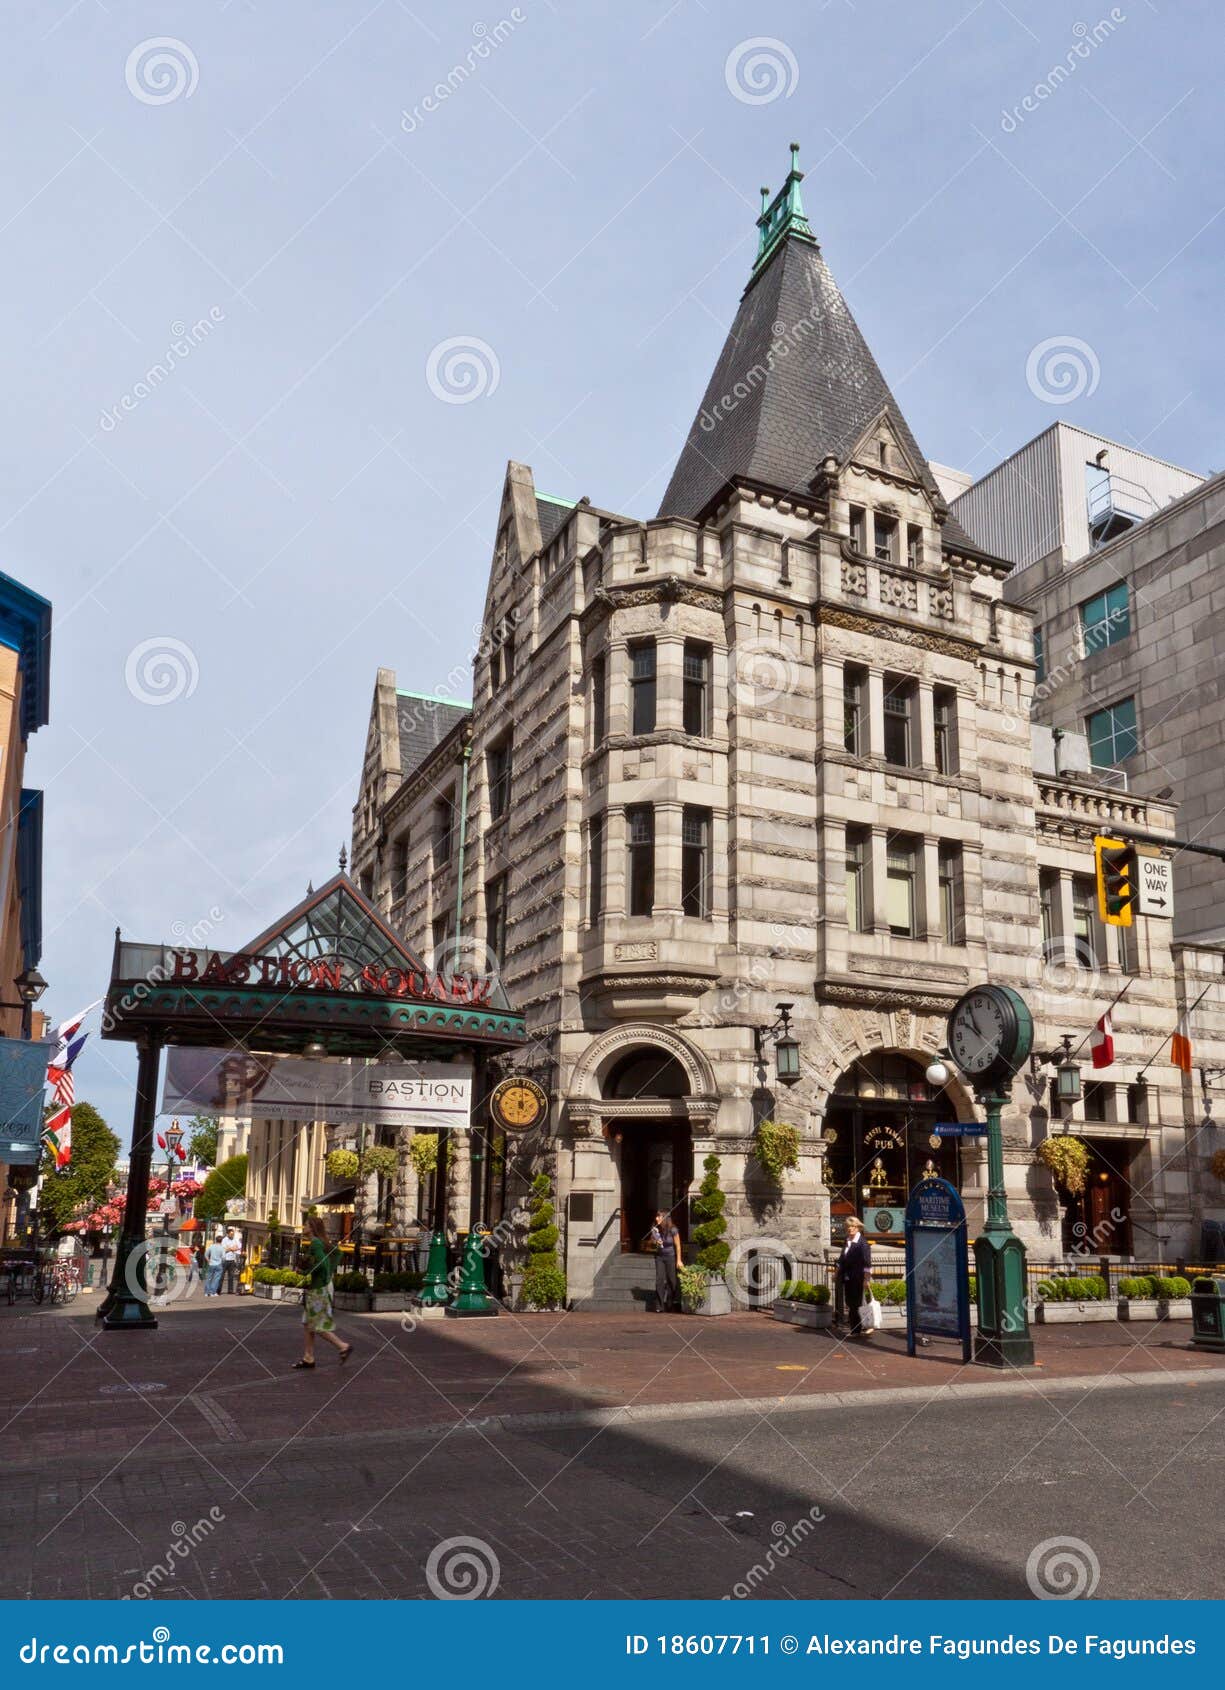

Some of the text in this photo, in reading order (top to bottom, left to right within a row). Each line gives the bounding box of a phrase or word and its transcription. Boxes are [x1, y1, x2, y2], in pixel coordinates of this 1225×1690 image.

[1144, 862, 1168, 878] ONE
[1145, 879, 1168, 892] WAY
[171, 950, 491, 1006] BASTION SQUARE
[368, 1073, 464, 1098] BASTION
[875, 1139, 894, 1150] PUB
[919, 1196, 951, 1205] MARITIME
[921, 1204, 950, 1213] MUSEUM
